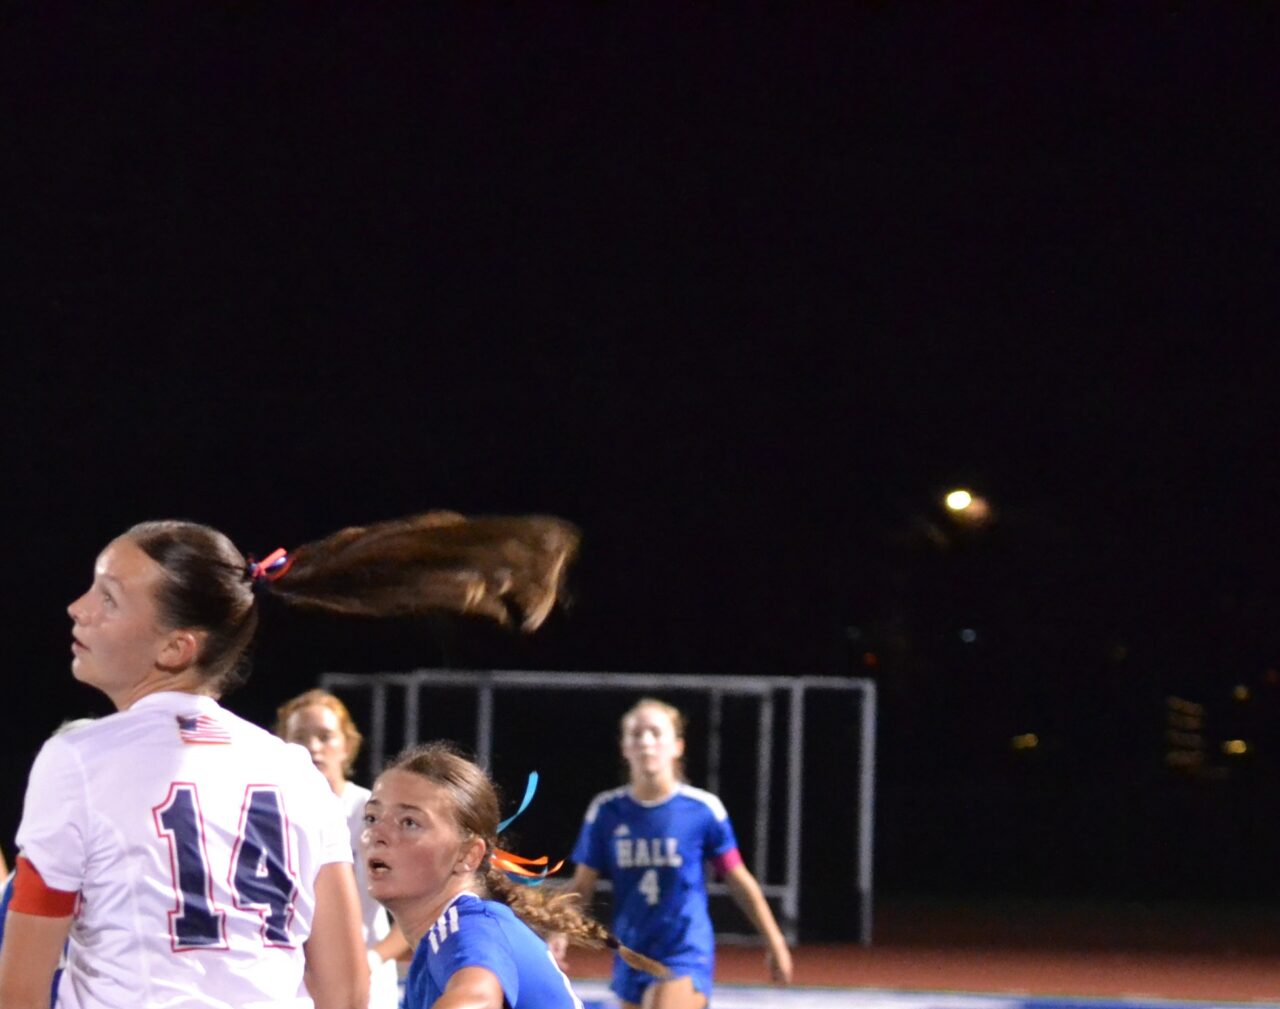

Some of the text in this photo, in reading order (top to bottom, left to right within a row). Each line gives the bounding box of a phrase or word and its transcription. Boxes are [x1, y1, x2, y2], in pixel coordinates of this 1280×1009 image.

[152, 782, 297, 952] 14
[616, 838, 683, 868] HALL
[639, 869, 660, 905] 4
